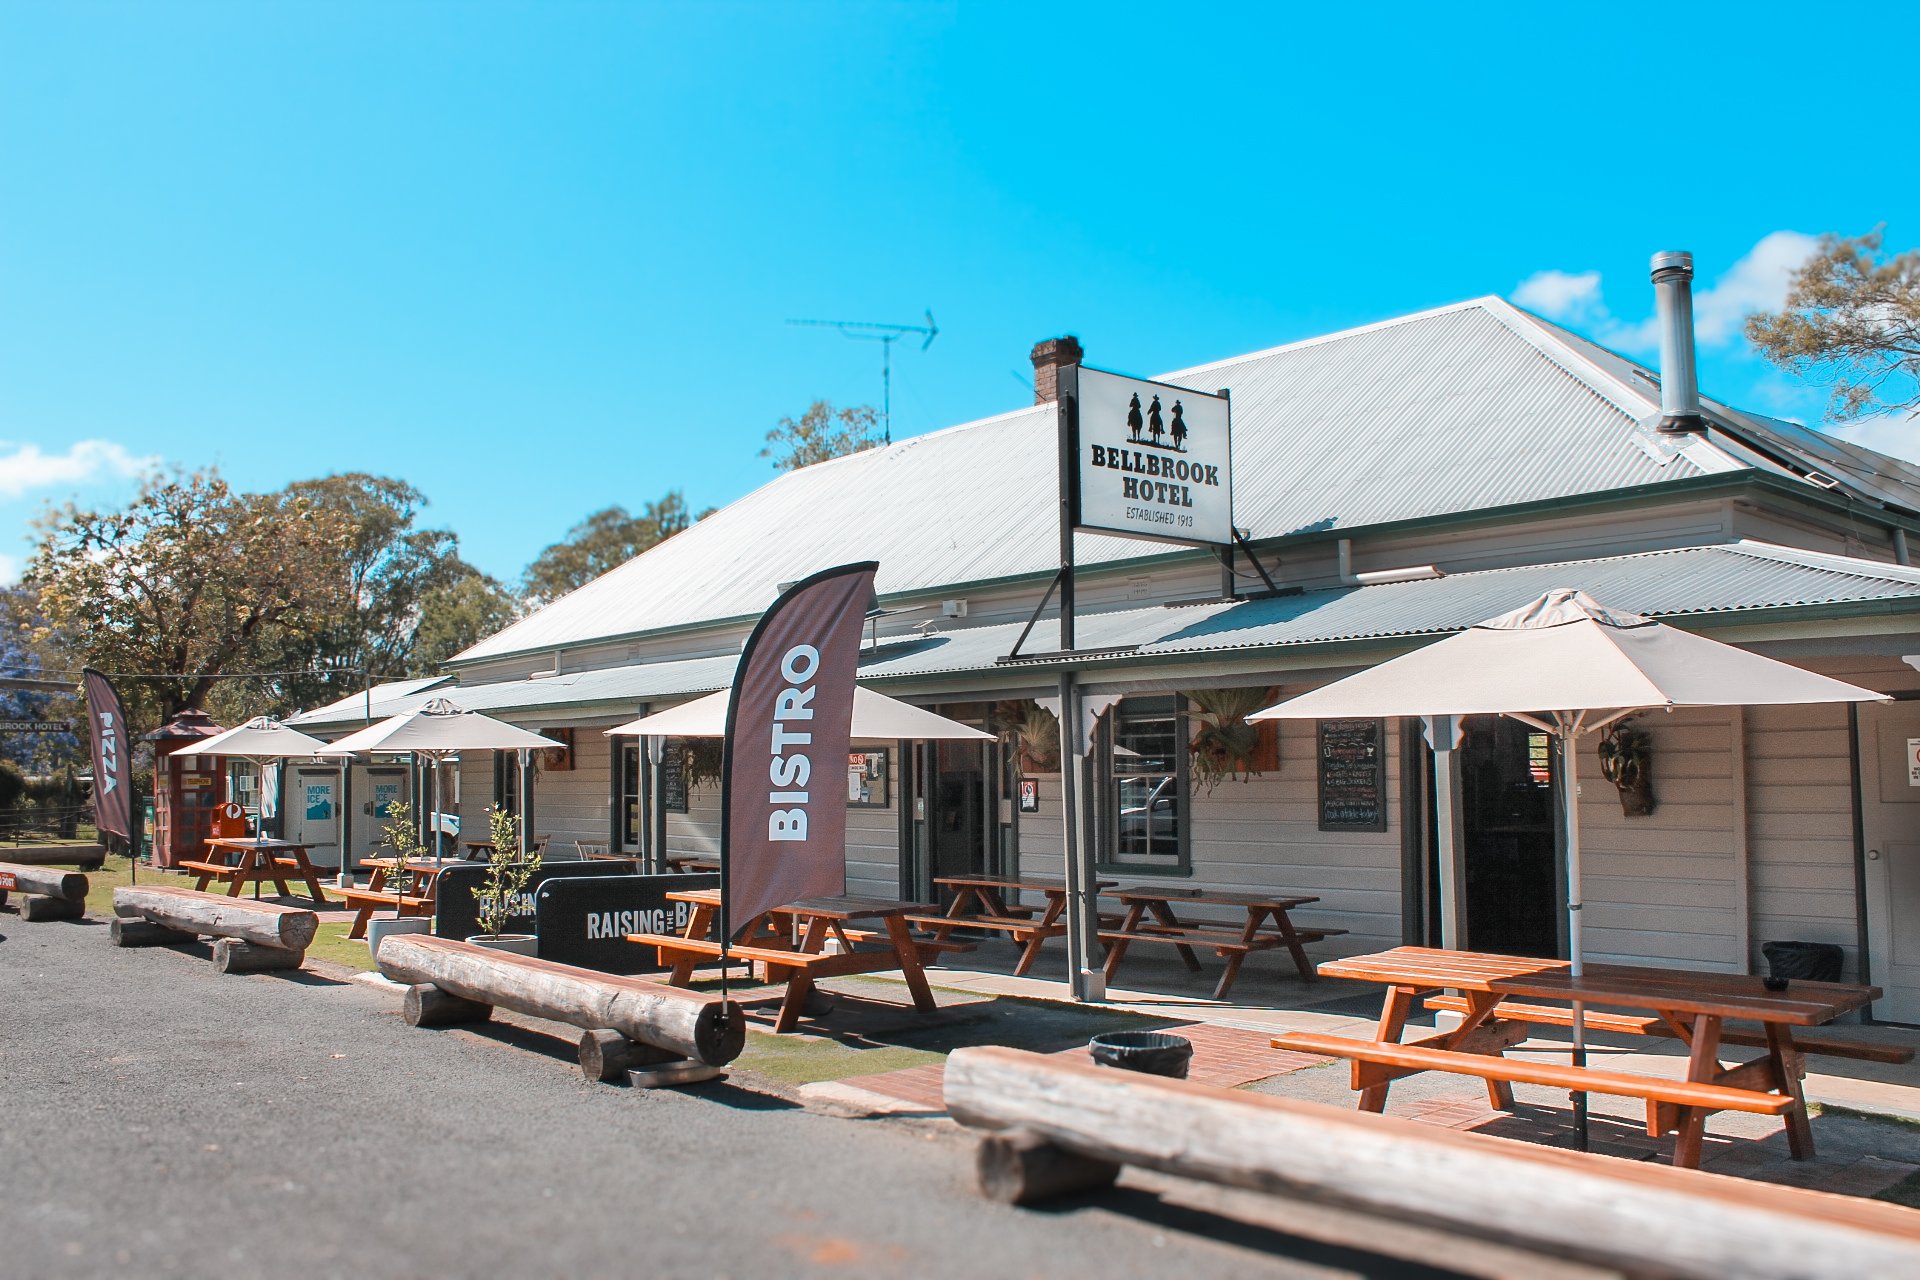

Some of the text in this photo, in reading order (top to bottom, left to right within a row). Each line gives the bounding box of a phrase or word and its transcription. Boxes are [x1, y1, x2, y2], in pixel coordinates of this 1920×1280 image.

[1091, 444, 1219, 487] BELLBROOK
[1122, 476, 1193, 508] HOTEL
[1126, 506, 1193, 528] ESTABLISHED 1913
[34, 722, 65, 732] HOTEL
[99, 712, 117, 795] PIZZA
[768, 643, 820, 842] BISTRO
[307, 785, 331, 795] MORE
[307, 794, 320, 804] ICE
[375, 784, 398, 794] MORE
[375, 793, 388, 802] ICE
[587, 908, 665, 940] RAISING
[666, 910, 674, 932] THE
